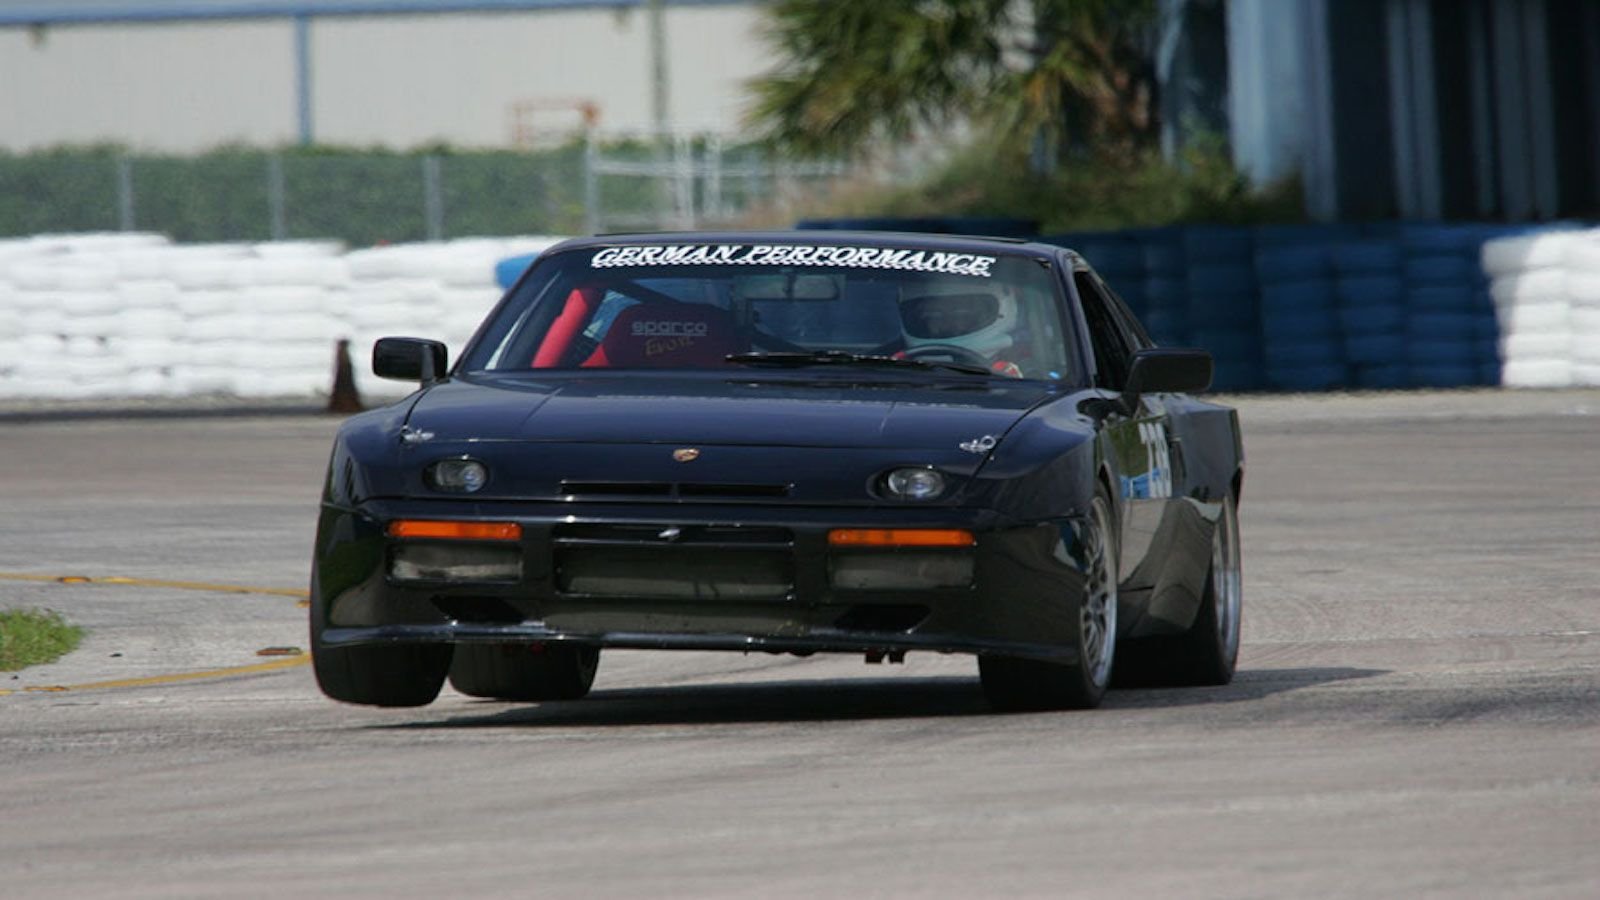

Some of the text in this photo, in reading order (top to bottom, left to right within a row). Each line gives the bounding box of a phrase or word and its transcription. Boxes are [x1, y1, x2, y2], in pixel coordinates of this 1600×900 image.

[592, 245, 996, 273] GERMAN PERFORMANCE
[631, 320, 708, 336] sparco
